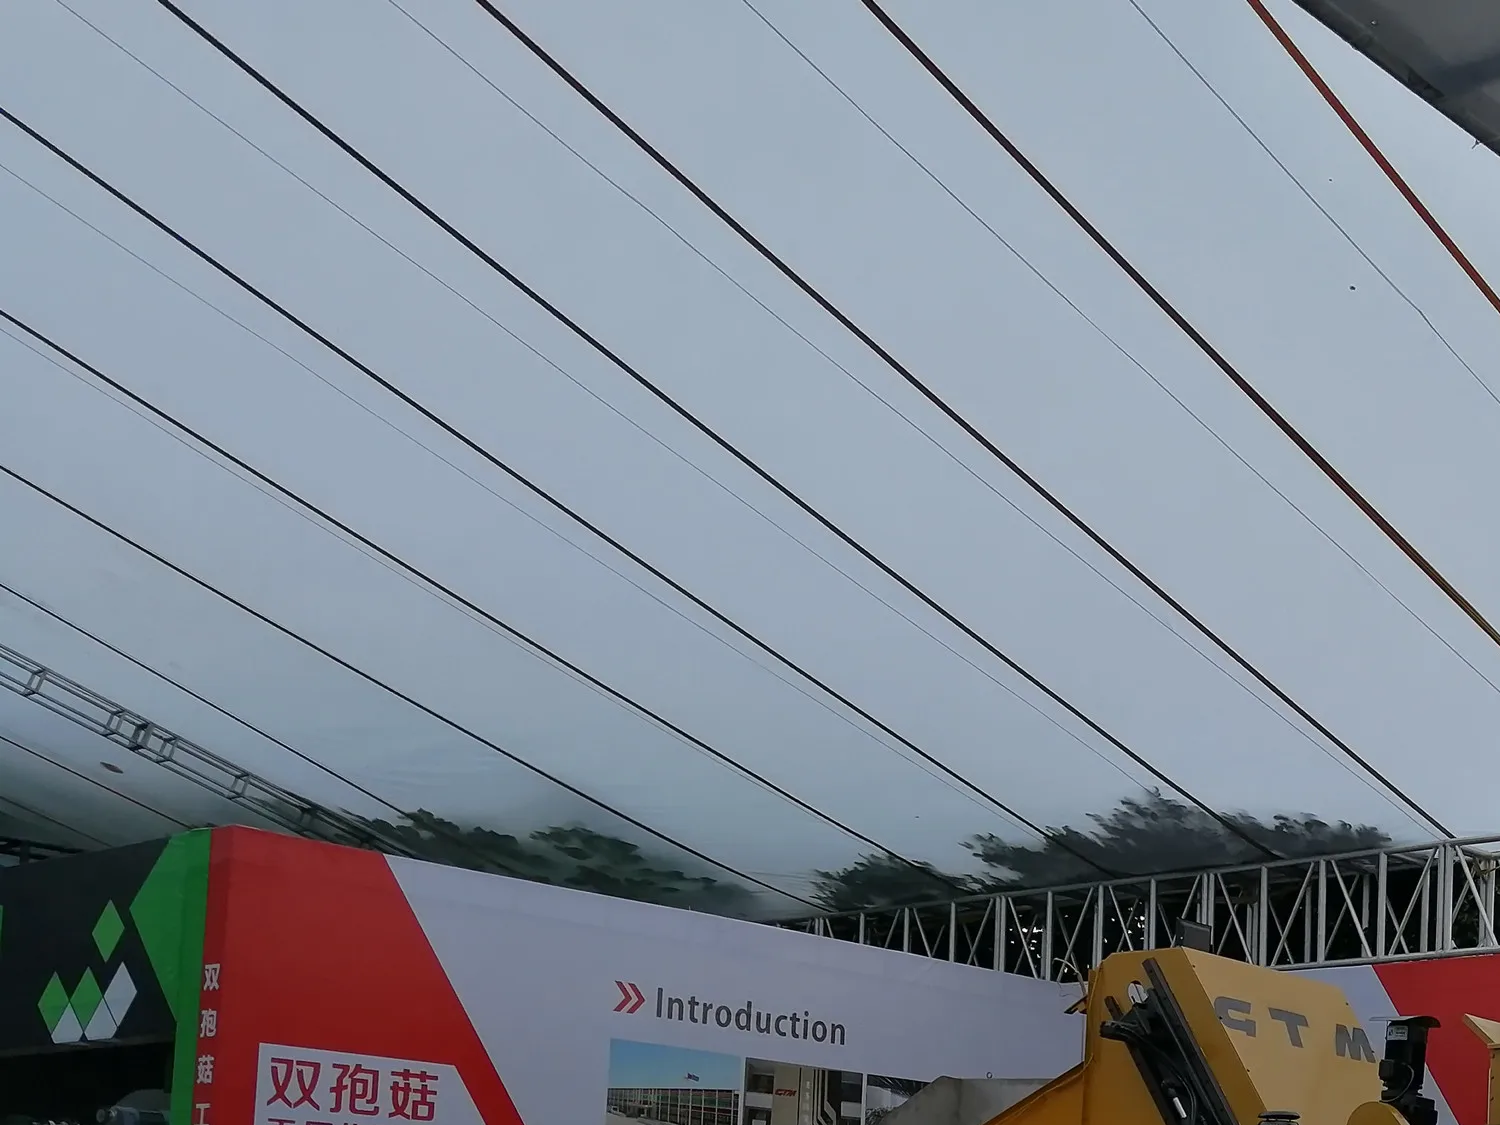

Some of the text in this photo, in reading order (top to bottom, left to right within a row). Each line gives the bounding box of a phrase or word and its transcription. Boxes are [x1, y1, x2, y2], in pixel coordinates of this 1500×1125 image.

[656, 987, 846, 1046] Introduction
[1213, 996, 1376, 1064] GTM
[267, 1057, 439, 1122] 双孢菇
